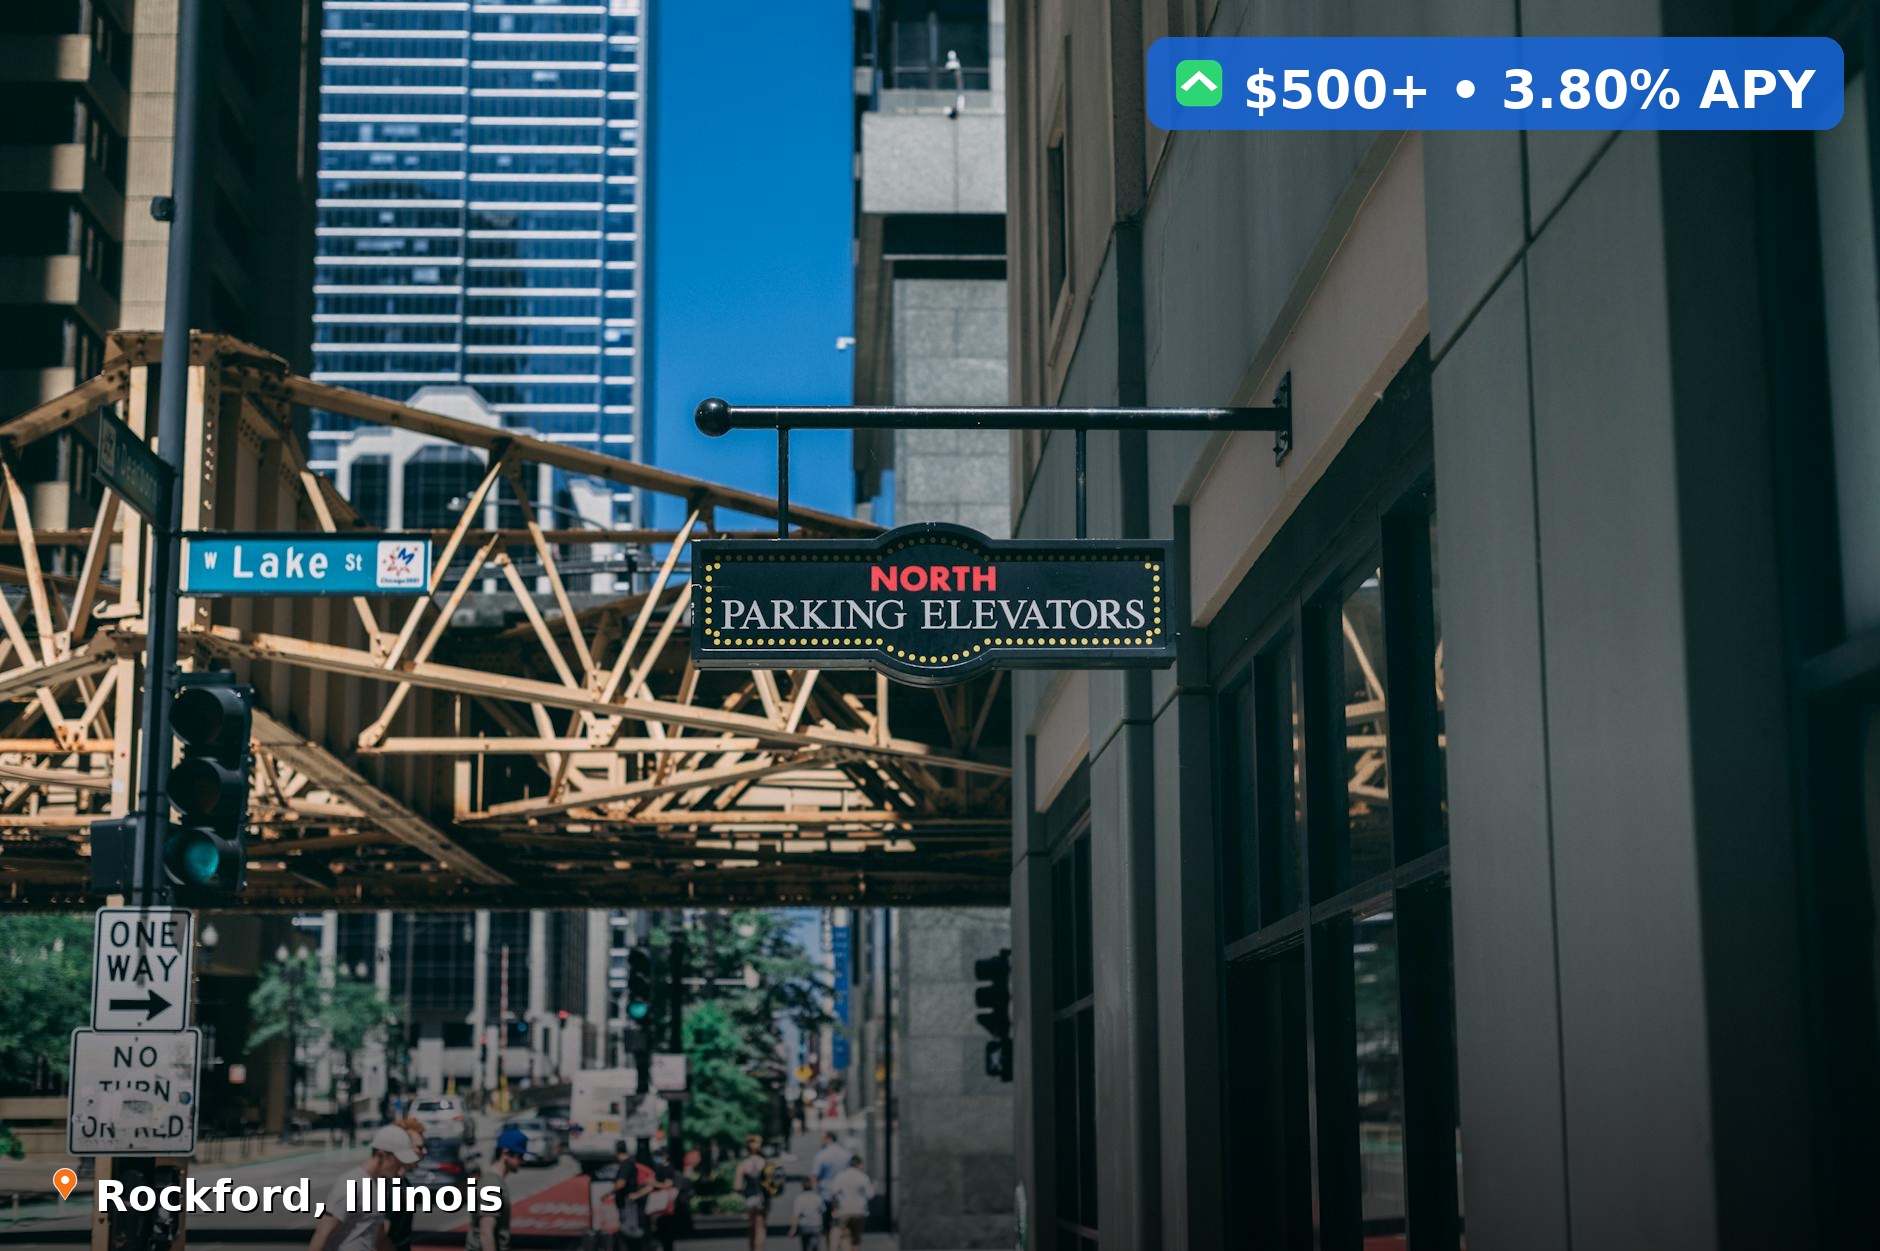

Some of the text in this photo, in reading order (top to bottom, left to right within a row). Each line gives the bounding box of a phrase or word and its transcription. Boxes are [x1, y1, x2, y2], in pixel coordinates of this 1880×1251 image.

[204, 545, 362, 579] W Lake St
[871, 565, 997, 592] NORTH
[721, 599, 1146, 630] PARKING ELEVATORS
[111, 921, 178, 948] ONE
[107, 955, 178, 982] WAY
[114, 1046, 157, 1068] NO
